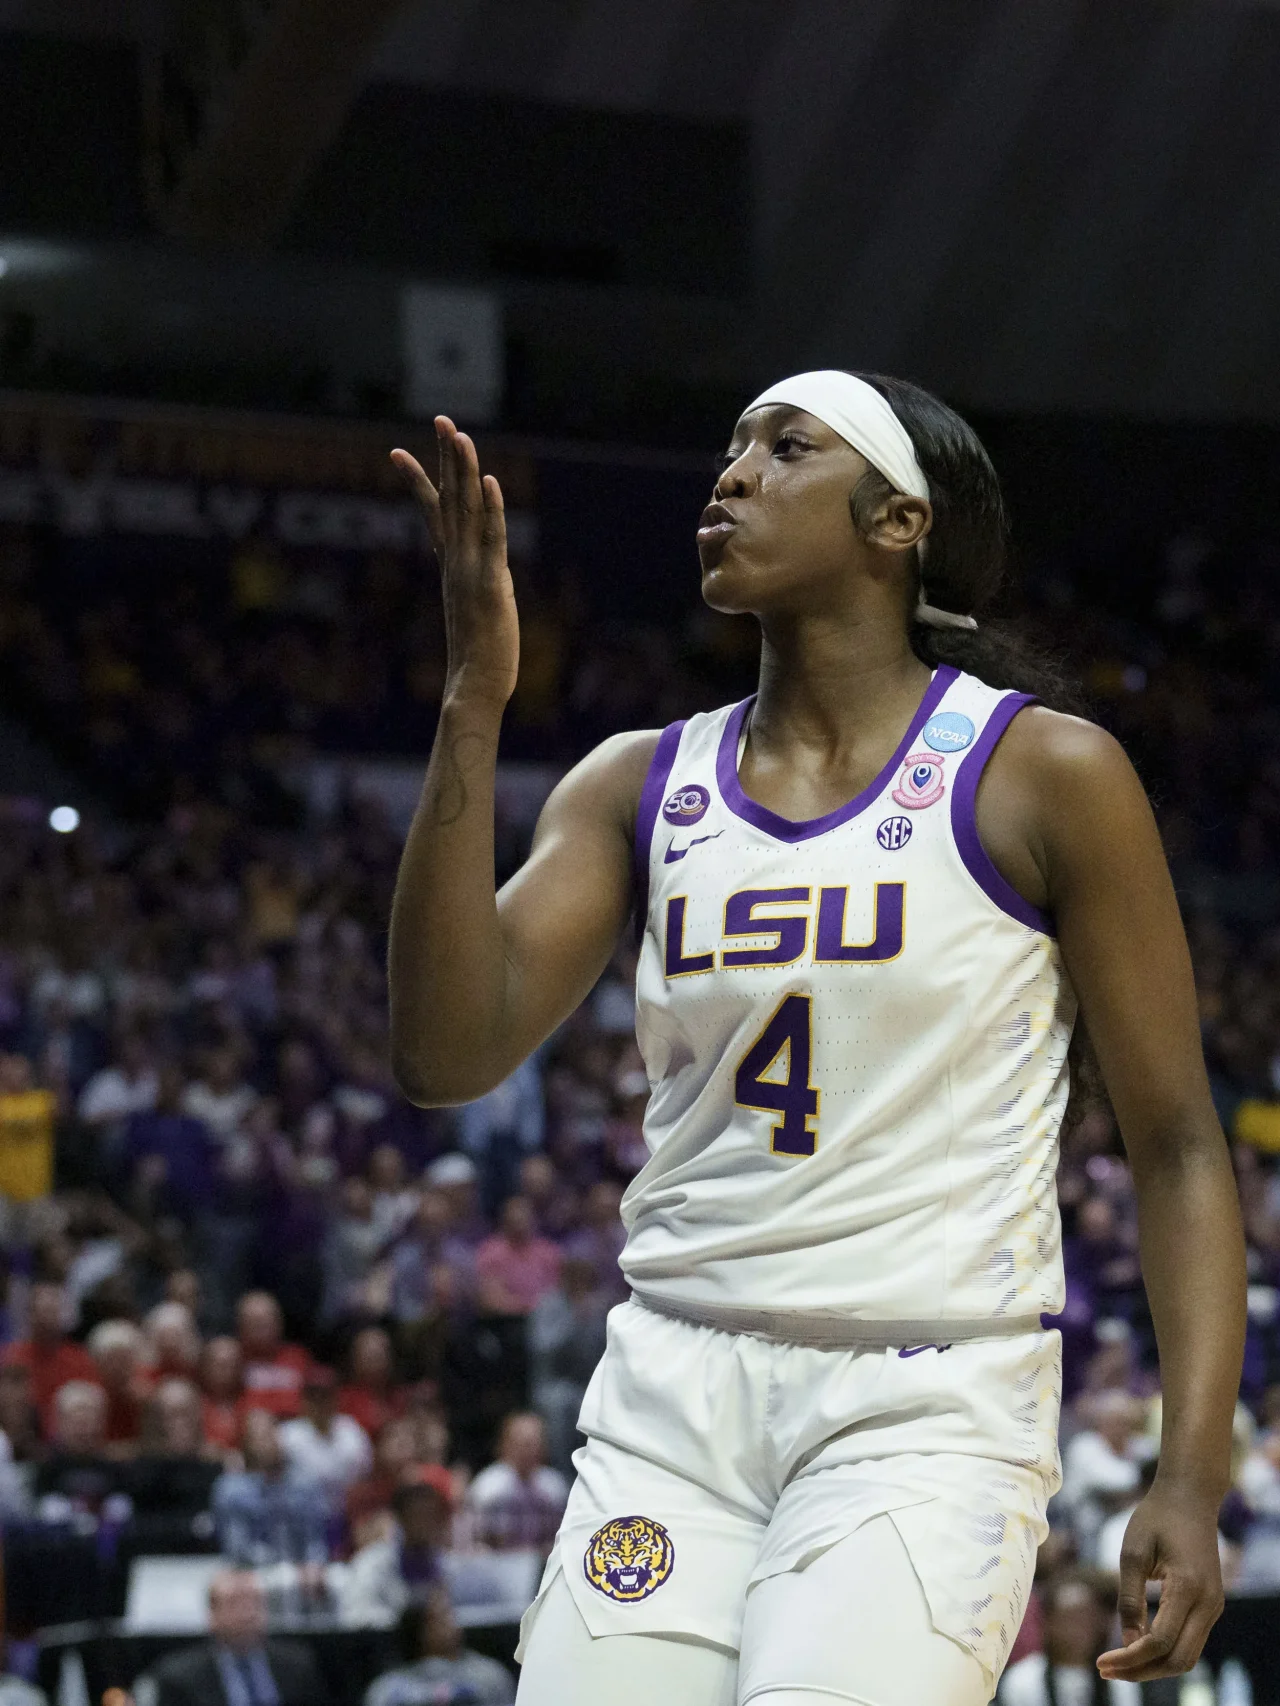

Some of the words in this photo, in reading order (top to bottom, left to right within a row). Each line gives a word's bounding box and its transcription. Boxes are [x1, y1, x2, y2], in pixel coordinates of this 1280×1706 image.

[929, 727, 969, 744] NCAA
[665, 791, 702, 814] 50
[879, 816, 911, 849] SEC
[664, 881, 907, 980] LSU
[734, 992, 821, 1158] 4
